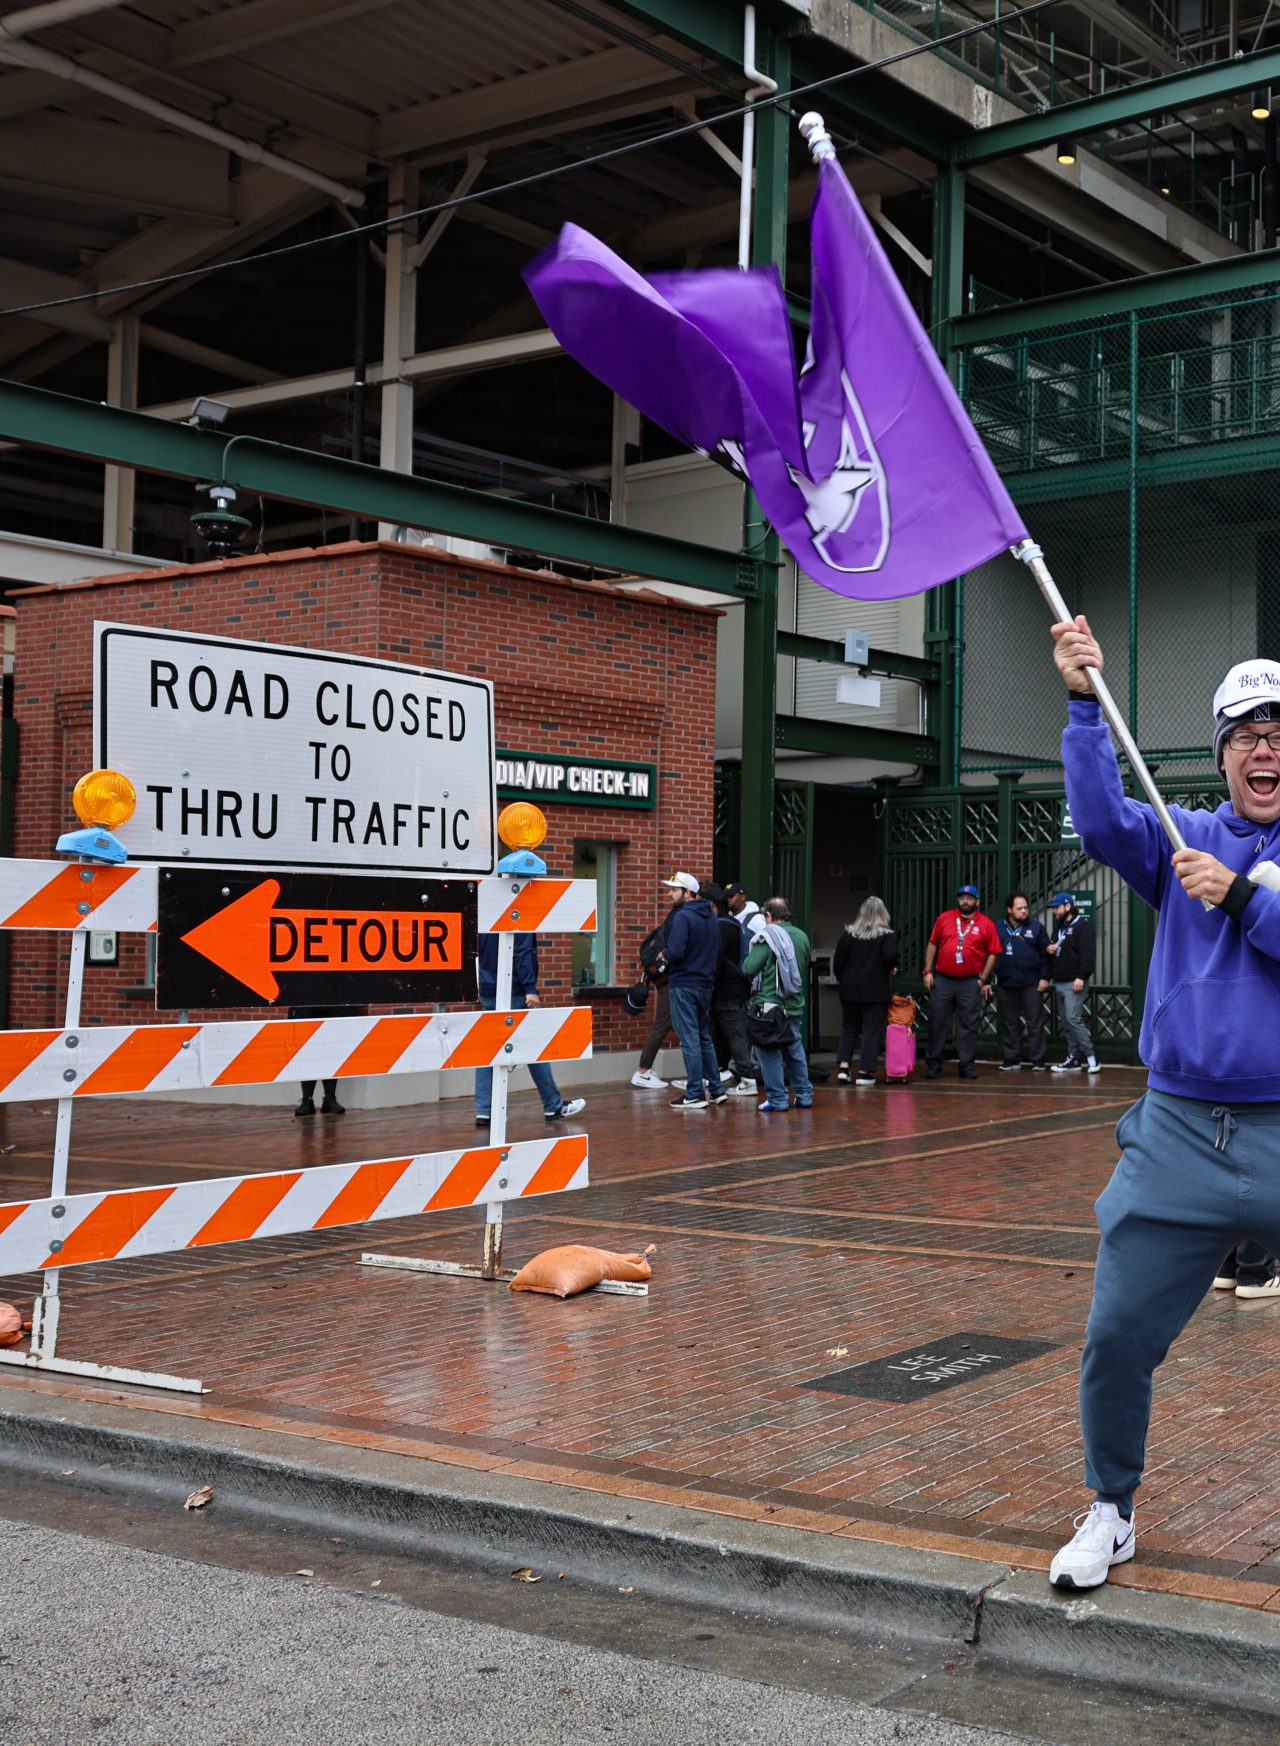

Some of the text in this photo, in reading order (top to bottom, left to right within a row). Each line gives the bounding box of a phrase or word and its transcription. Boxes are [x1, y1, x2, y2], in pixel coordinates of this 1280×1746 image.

[1238, 674, 1260, 689] Big
[151, 660, 466, 742] ROAD CLOSED
[309, 741, 352, 782] TO
[567, 766, 649, 798] CHECK-IN
[146, 785, 470, 851] THRU TRAFFIC
[269, 917, 449, 964] DETOUR
[887, 1353, 948, 1371] LEE
[910, 1353, 1002, 1383] SMITH
